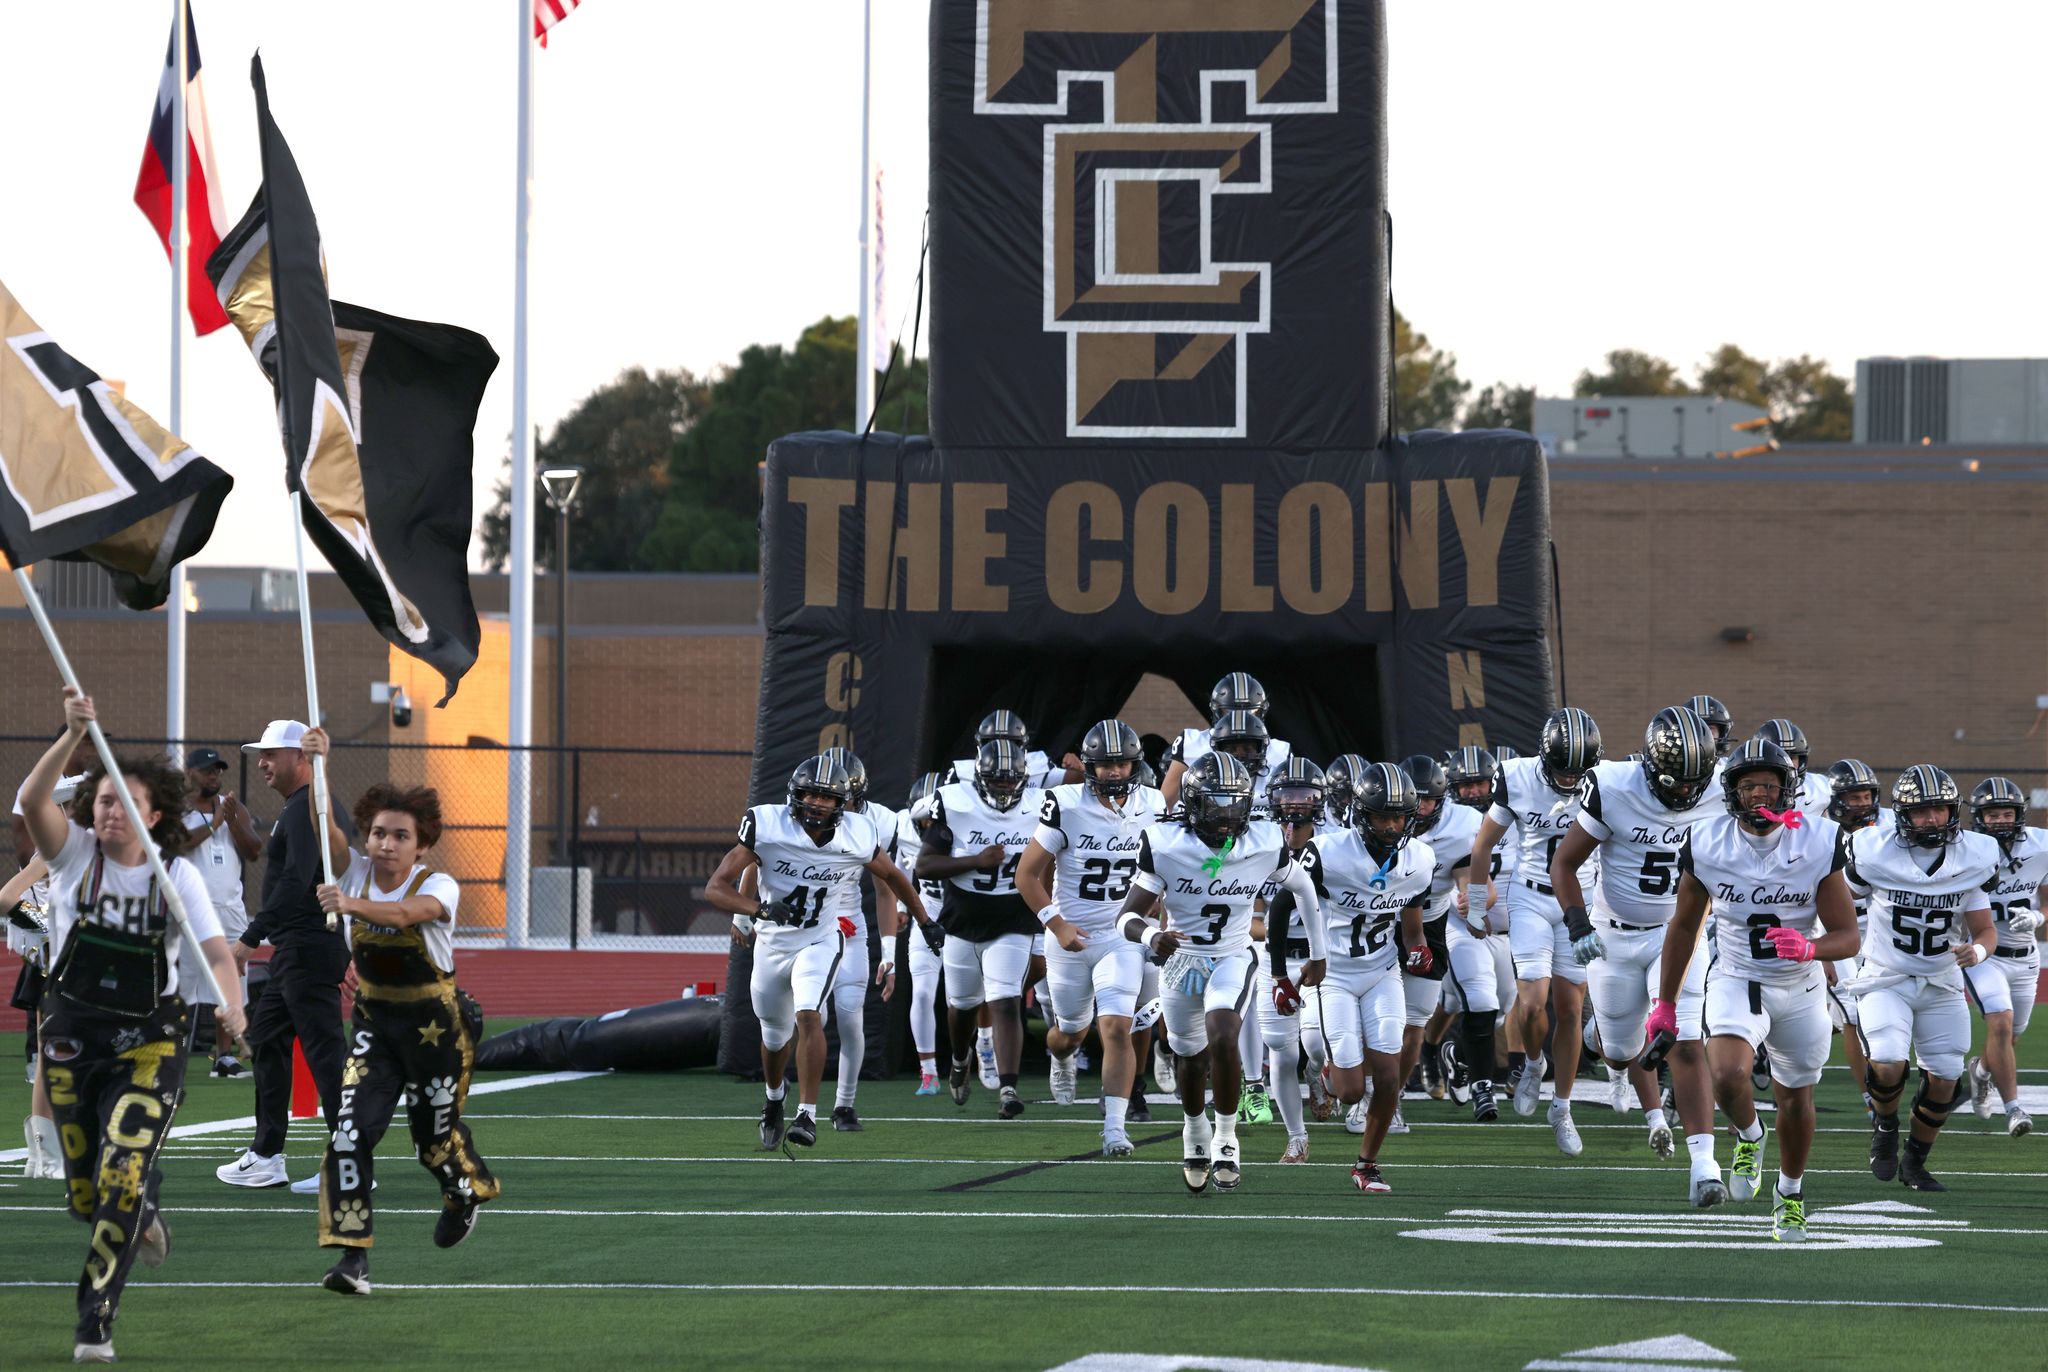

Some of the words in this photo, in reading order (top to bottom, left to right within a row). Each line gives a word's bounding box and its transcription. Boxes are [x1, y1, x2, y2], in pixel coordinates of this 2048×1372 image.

[787, 477, 1009, 613] THE
[1045, 475, 1521, 615] COLONY
[1527, 811, 1552, 829] The
[966, 830, 991, 846] The
[994, 831, 1032, 846] Colon
[1076, 834, 1102, 851] The
[1106, 836, 1141, 852] Colon
[1629, 826, 1657, 844] The
[772, 860, 799, 877] The
[802, 865, 845, 885] Colony
[1079, 857, 1138, 902] 23
[1638, 851, 1681, 896] 5
[1174, 877, 1203, 895] The
[1207, 879, 1258, 899] Colony
[1261, 880, 1278, 896] Th
[1717, 882, 1745, 904] The
[1751, 885, 1812, 907] Colony
[1994, 878, 2039, 896] Colony
[782, 884, 829, 929] 41
[1337, 891, 1366, 909] The
[1887, 889, 1910, 906] THE
[1913, 891, 1965, 910] COLONY
[1190, 903, 1232, 946] 3
[1349, 912, 1396, 959] 12
[1891, 906, 1954, 957] 52
